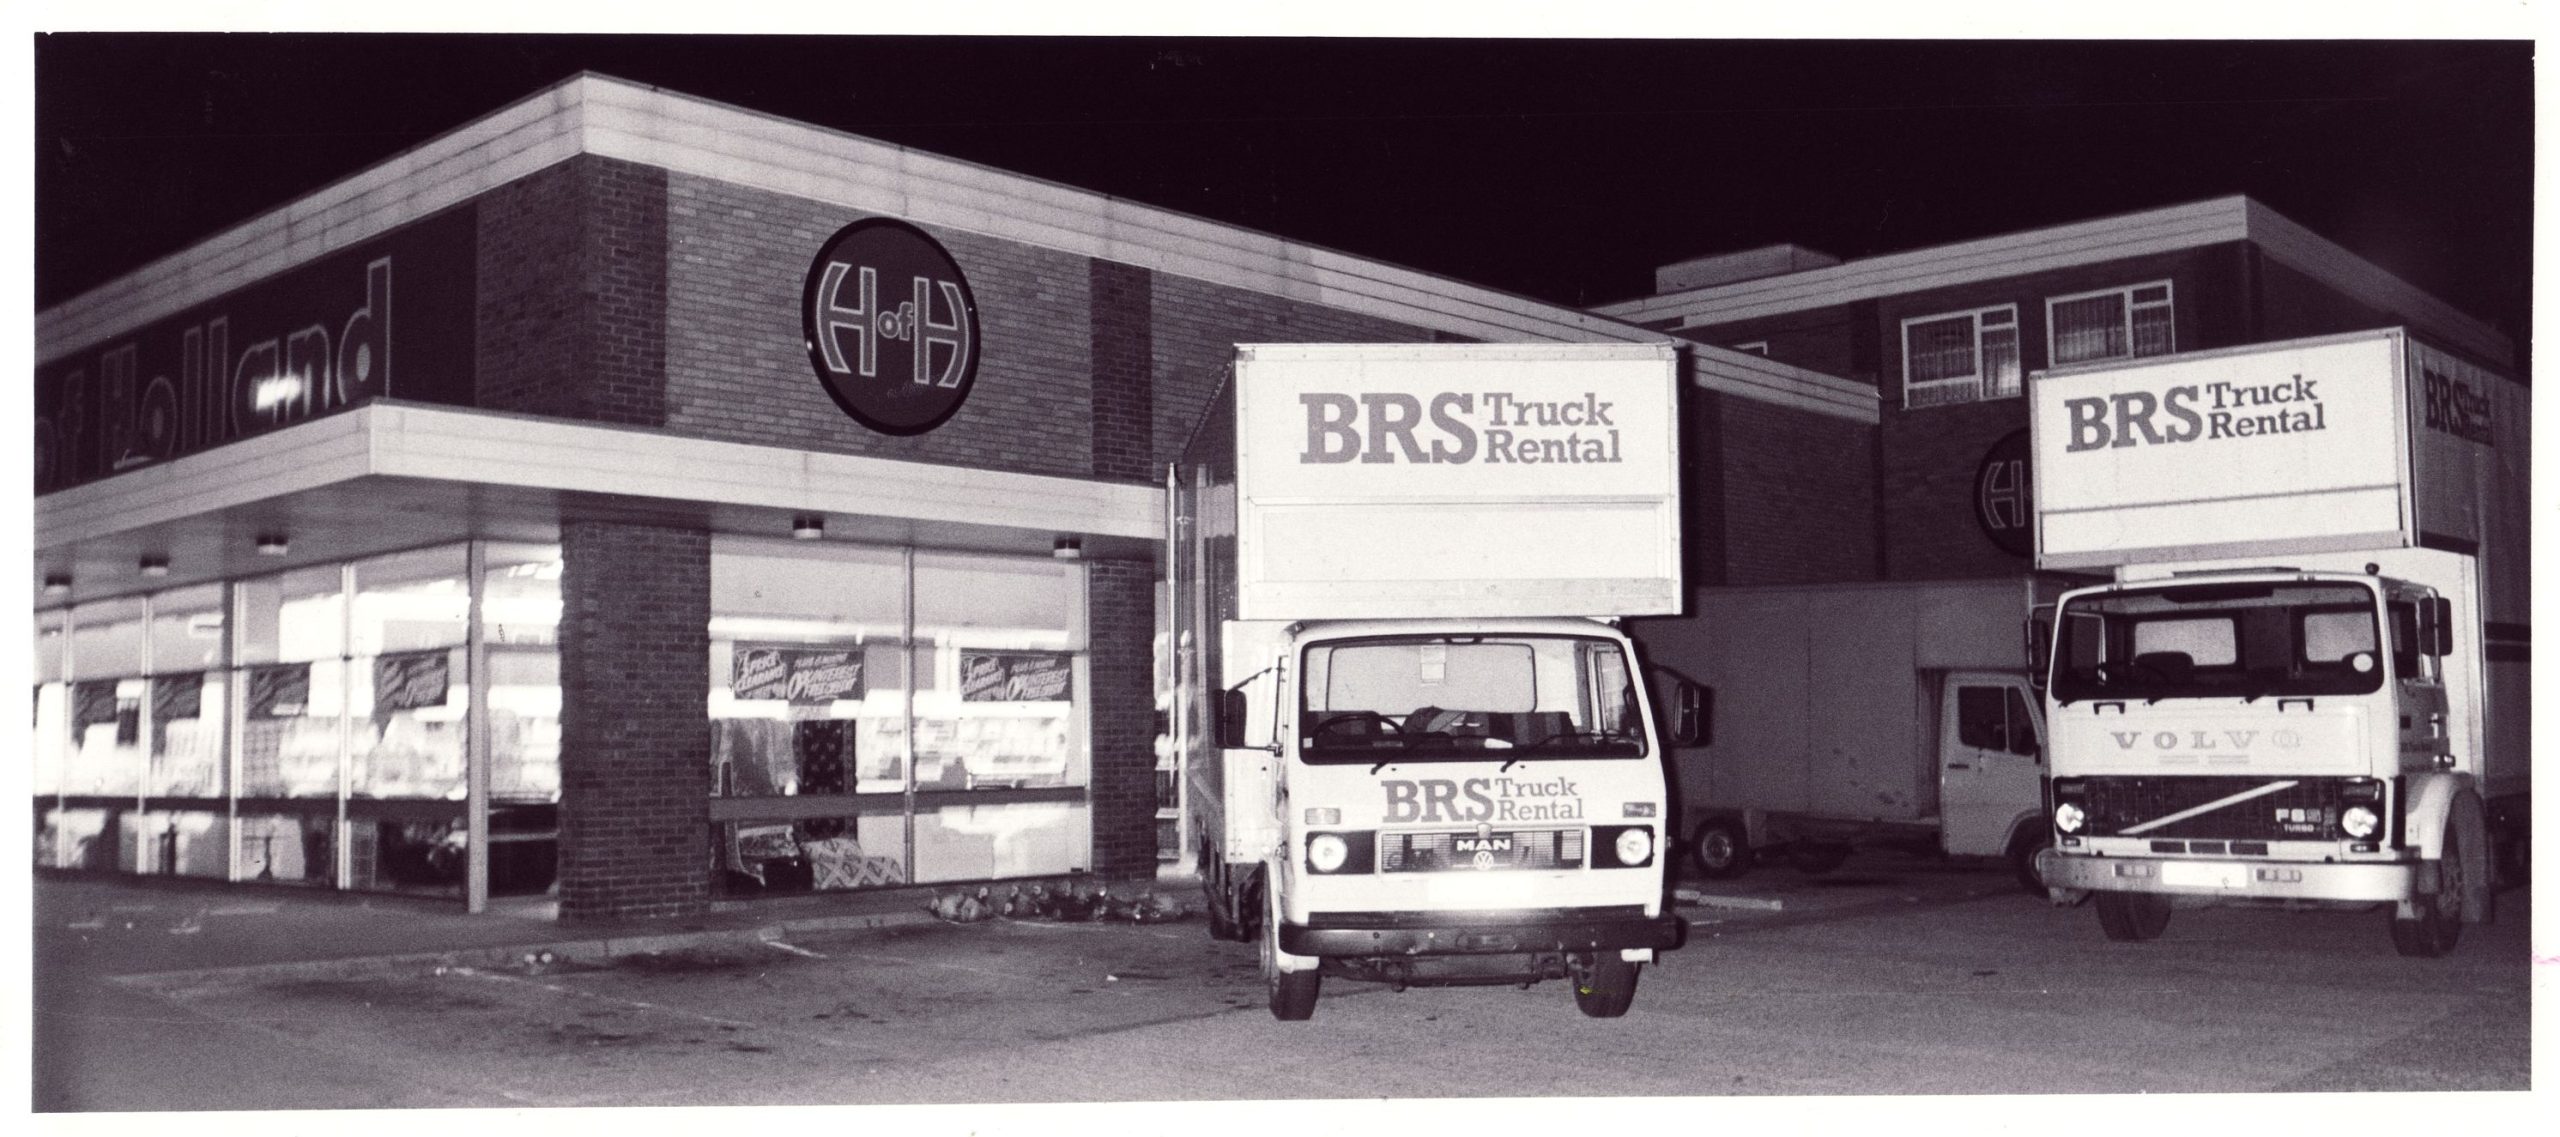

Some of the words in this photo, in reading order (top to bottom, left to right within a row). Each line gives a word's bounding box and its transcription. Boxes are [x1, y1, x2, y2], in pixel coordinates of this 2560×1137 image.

[102, 255, 391, 474] Holland
[2064, 385, 2203, 453] BRS
[2206, 374, 2318, 409] Truck
[2207, 403, 2326, 439] Rental
[2423, 368, 2469, 438] BRS
[1299, 392, 1478, 464] BRS
[1483, 392, 1614, 426] Truck
[1484, 429, 1622, 463] Rental
[2110, 730, 2302, 750] VOLVO
[1380, 778, 1495, 823] BRS
[1494, 776, 1579, 798] Truck
[1497, 798, 1585, 821] Rental
[1456, 839, 1511, 851] MAN
[2283, 823, 2315, 833] TURBO
